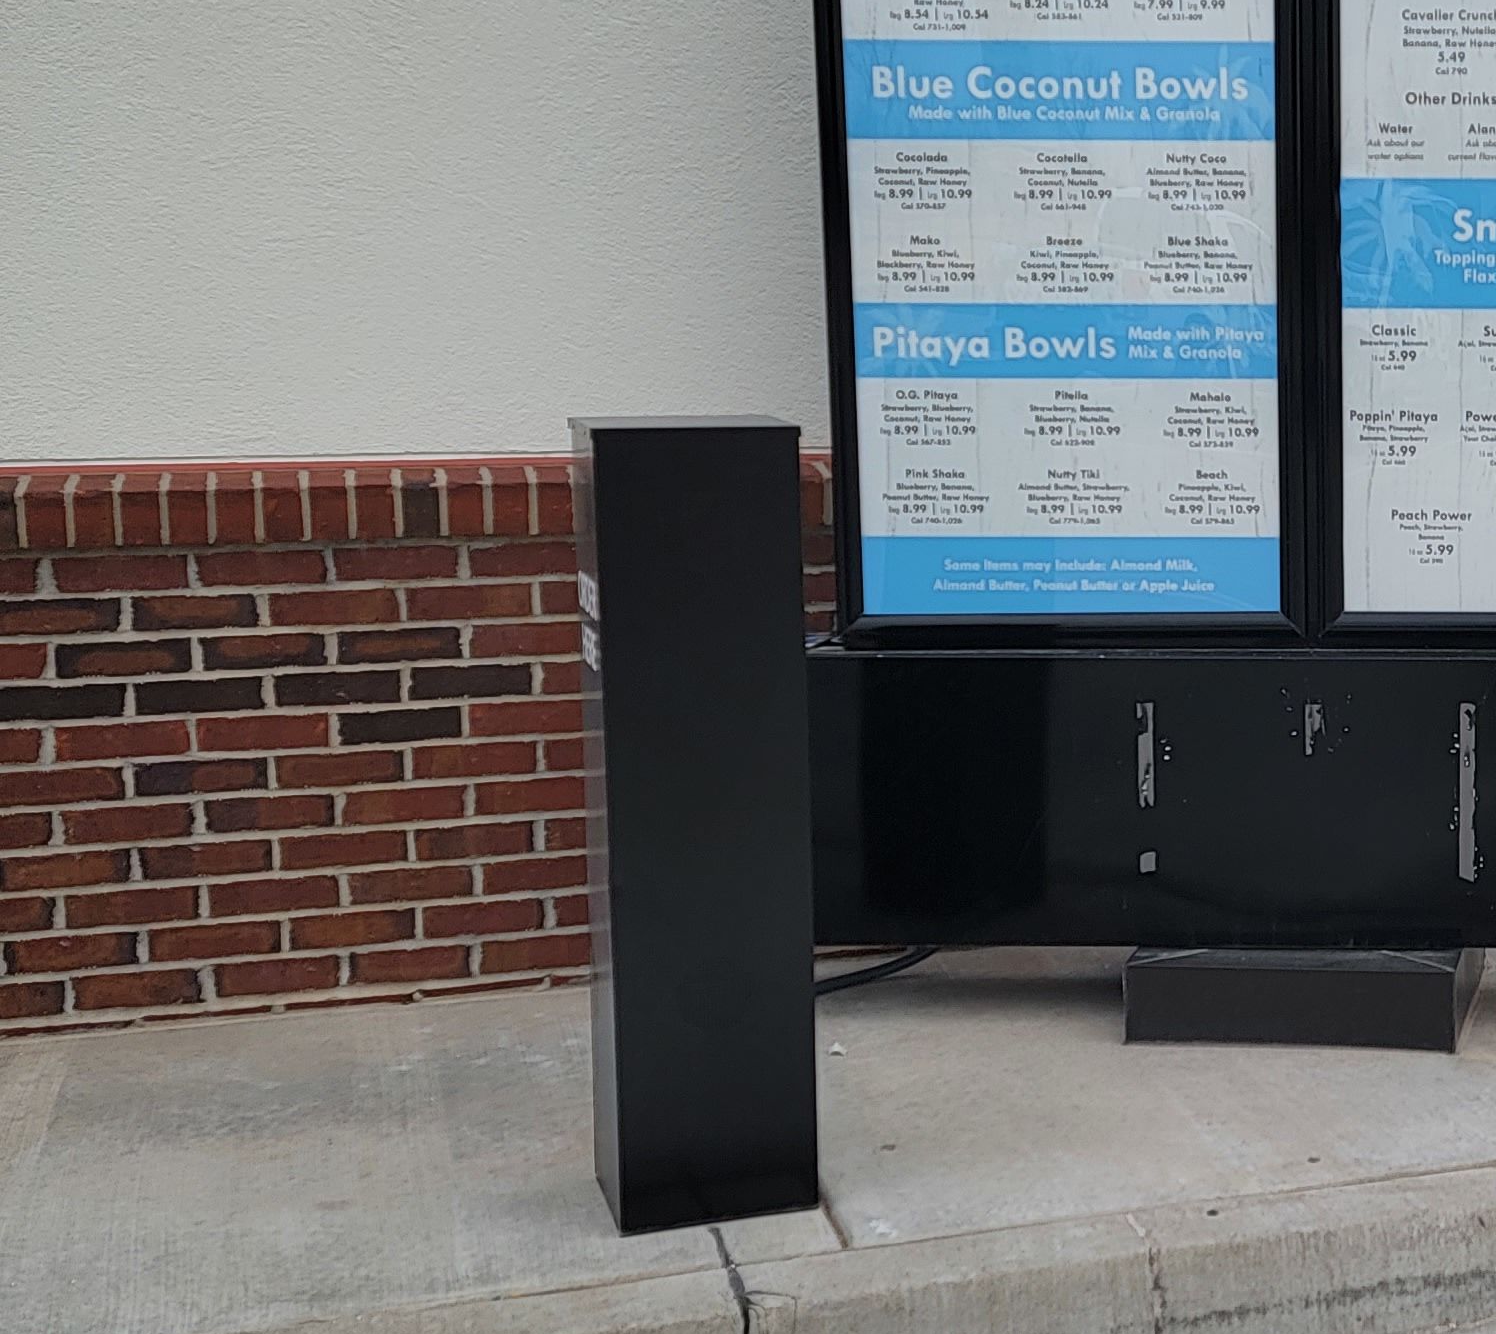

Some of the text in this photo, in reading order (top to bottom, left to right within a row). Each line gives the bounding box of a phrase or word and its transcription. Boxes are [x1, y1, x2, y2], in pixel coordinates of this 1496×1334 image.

[1402, 9, 1454, 21] Cavalier
[1438, 51, 1466, 63] 5.49
[872, 66, 1249, 100] Blue Coconut Bowls
[1405, 91, 1496, 105] Other Drinks
[909, 105, 1221, 121] Made with Blue Coconut Mix & Granola
[1378, 123, 1413, 134] Water
[896, 152, 948, 162] Cocolada
[1166, 153, 1227, 165] Nutty Coco
[888, 188, 972, 199] 8.99 10.99
[1168, 236, 1228, 247] Blue Shaka
[1464, 268, 1496, 283] Flax
[1128, 326, 1264, 345] Made with Pitaya
[1372, 324, 1416, 337] Classic
[873, 325, 1116, 366] Pitaya Bowls
[1129, 345, 1242, 361] Mix & Granola
[1388, 350, 1417, 361] 5.99
[924, 389, 958, 402] Pitaya
[1399, 410, 1438, 425] Pitaya
[894, 425, 976, 435] 8.99 10.99
[1388, 445, 1416, 457] 5.99
[905, 469, 965, 479] Pink Shaka
[1048, 469, 1100, 481] Nutty Tiki
[1196, 469, 1228, 479] Beach
[1391, 509, 1472, 521] Peach Power
[1425, 544, 1454, 555] 5.99
[984, 559, 1018, 571] Items
[1023, 562, 1051, 572] may
[1110, 559, 1162, 571] Almond
[934, 579, 985, 590] Almond
[1034, 579, 1078, 591] Peanut
[1080, 579, 1118, 591] Butter
[1122, 581, 1136, 591] or
[1138, 579, 1179, 594] Apple
[1181, 579, 1215, 591] Juice
